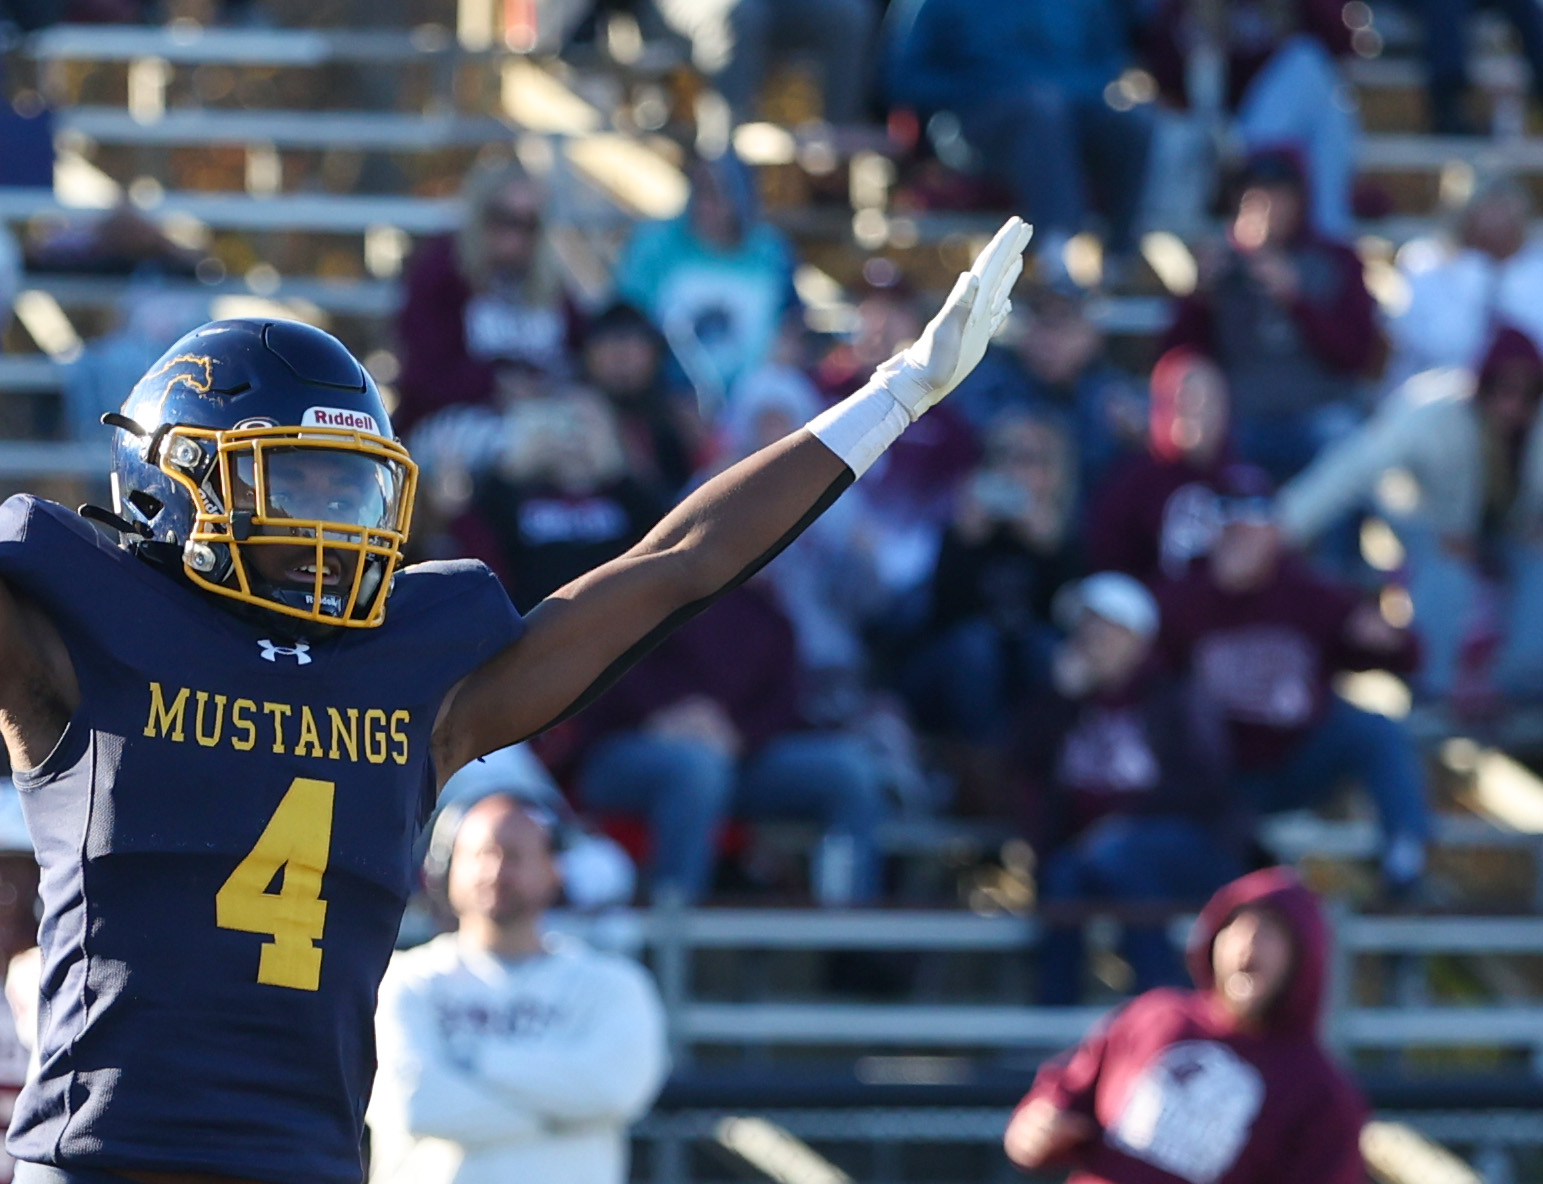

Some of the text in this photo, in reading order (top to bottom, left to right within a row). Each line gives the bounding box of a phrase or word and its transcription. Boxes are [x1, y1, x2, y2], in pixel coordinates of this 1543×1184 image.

[314, 409, 375, 431] Riddell
[142, 680, 411, 766] MUSTANGS
[215, 776, 336, 992] 4
